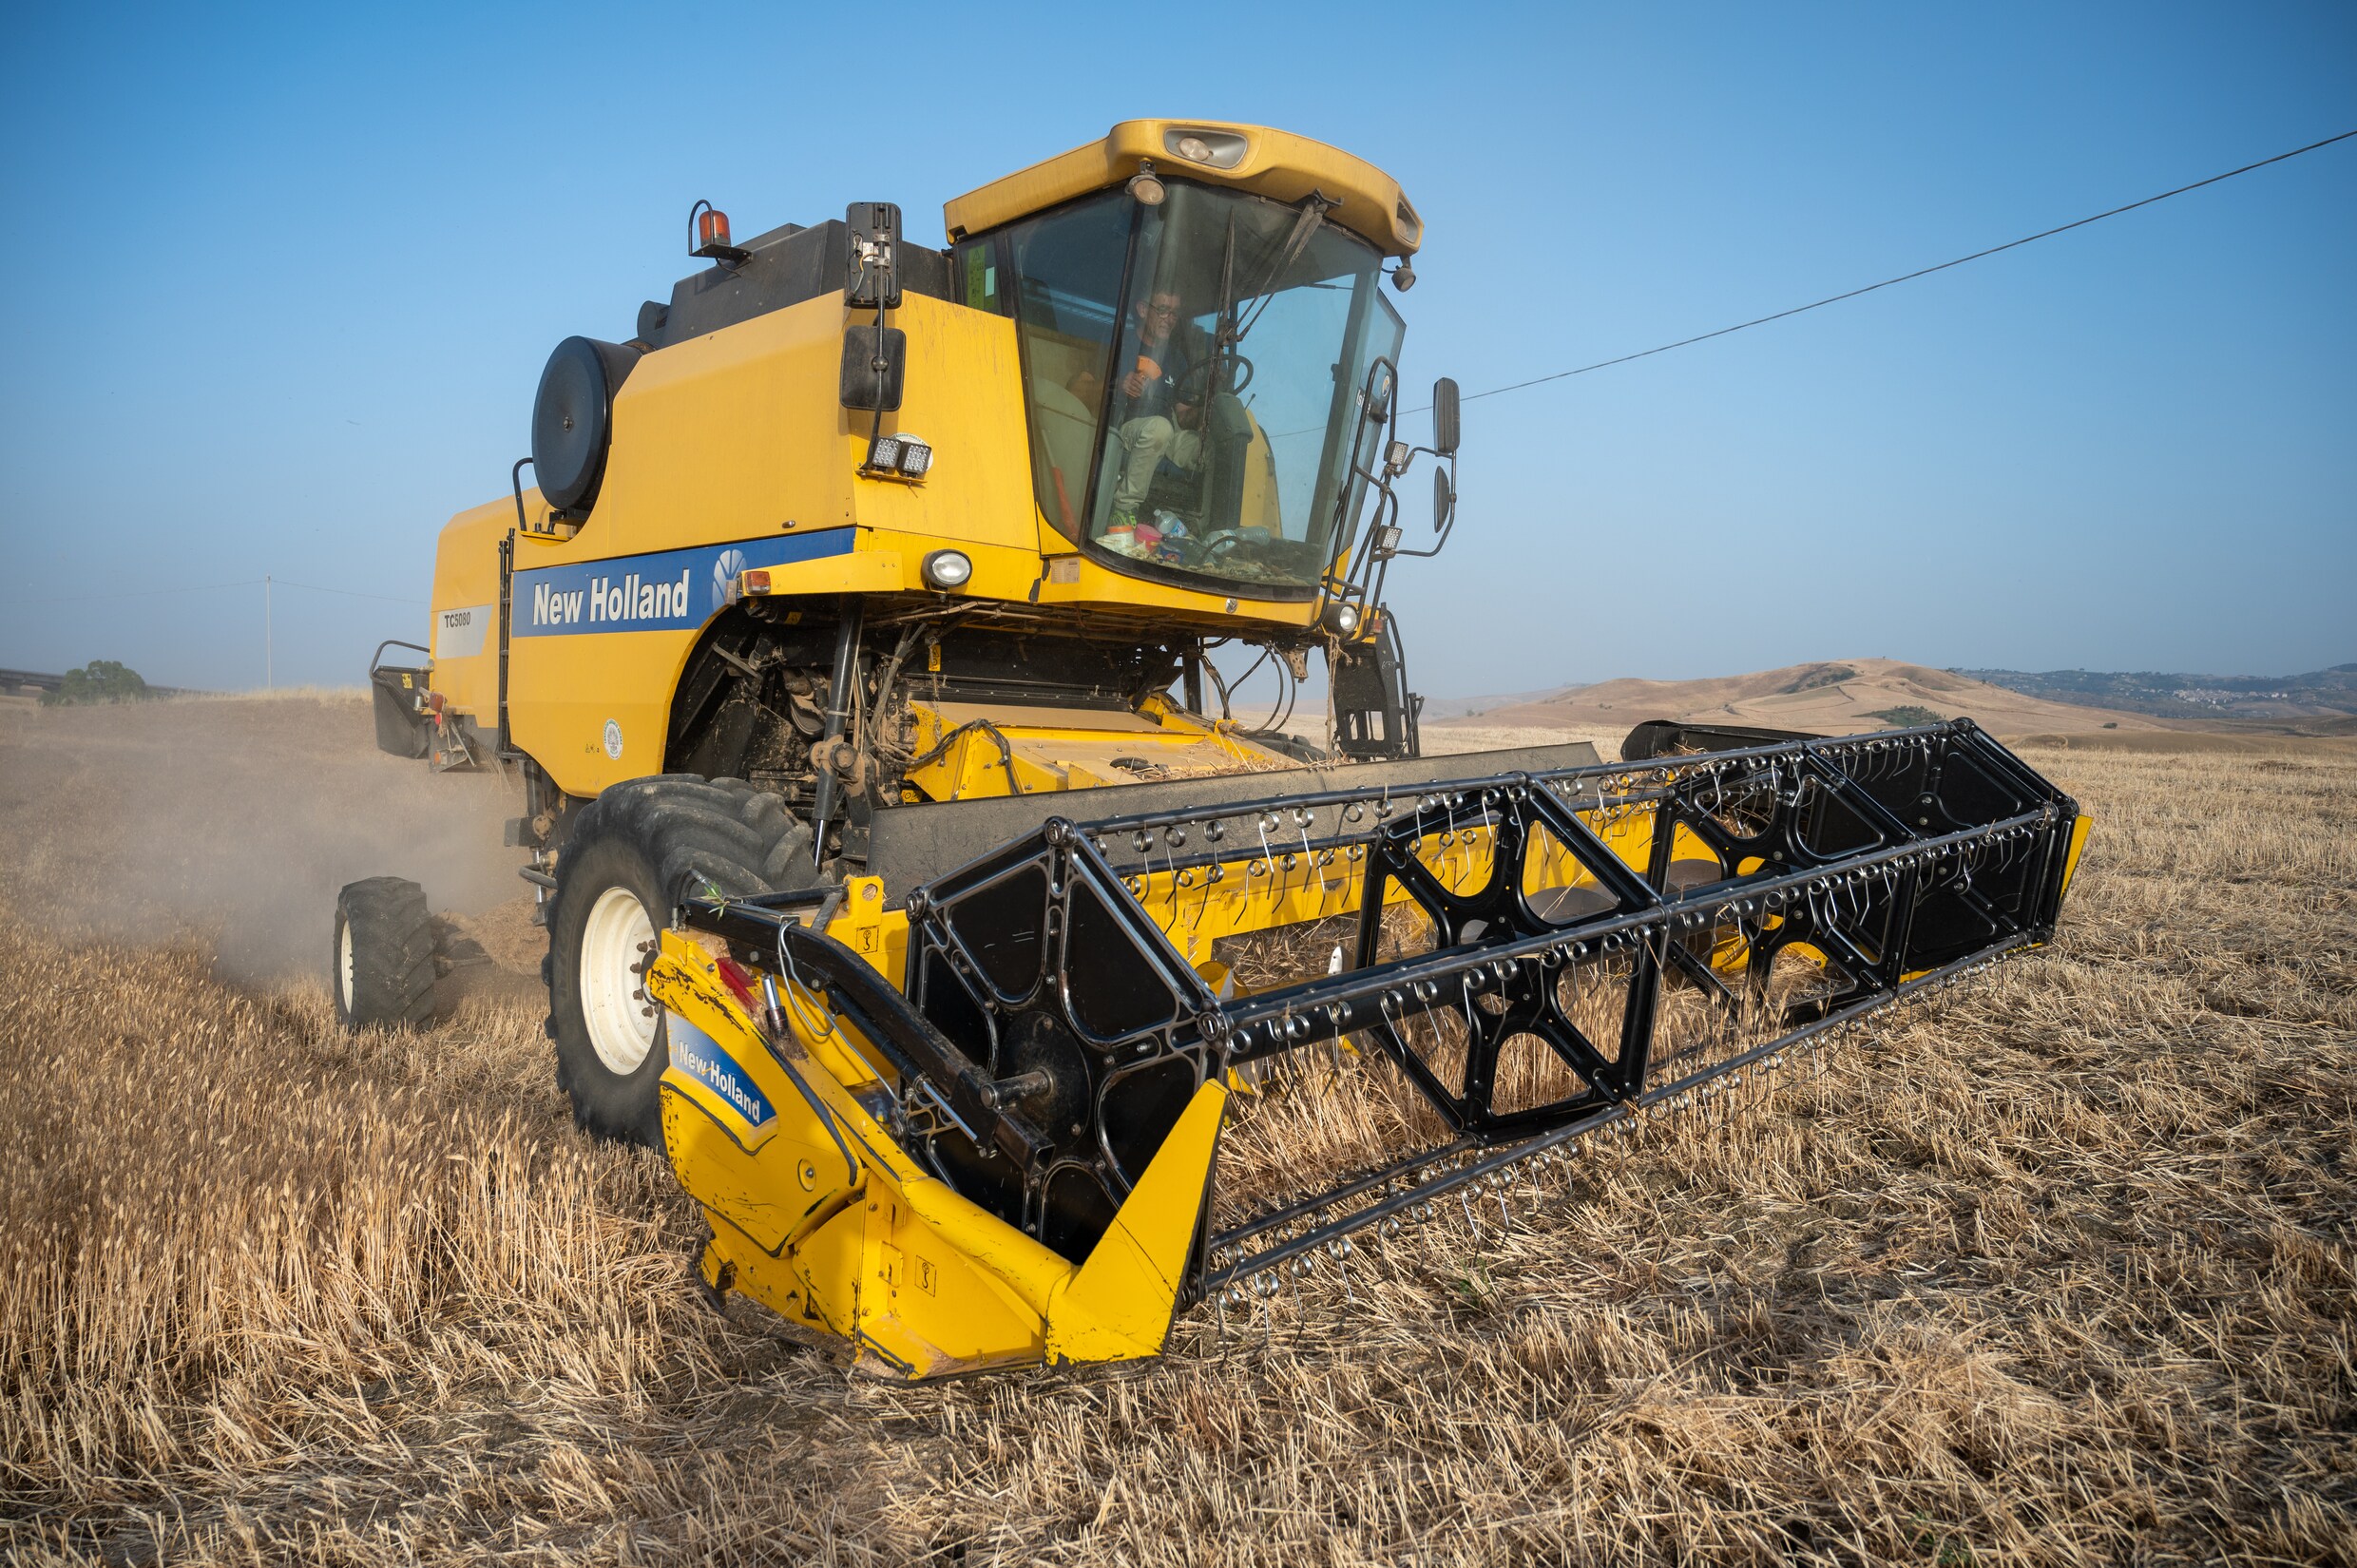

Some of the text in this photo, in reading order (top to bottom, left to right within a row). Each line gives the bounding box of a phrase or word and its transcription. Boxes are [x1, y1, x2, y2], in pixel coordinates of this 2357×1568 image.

[444, 611, 471, 628] TC5080
[532, 567, 690, 625] New Holland
[679, 1041, 760, 1123] New Holland
